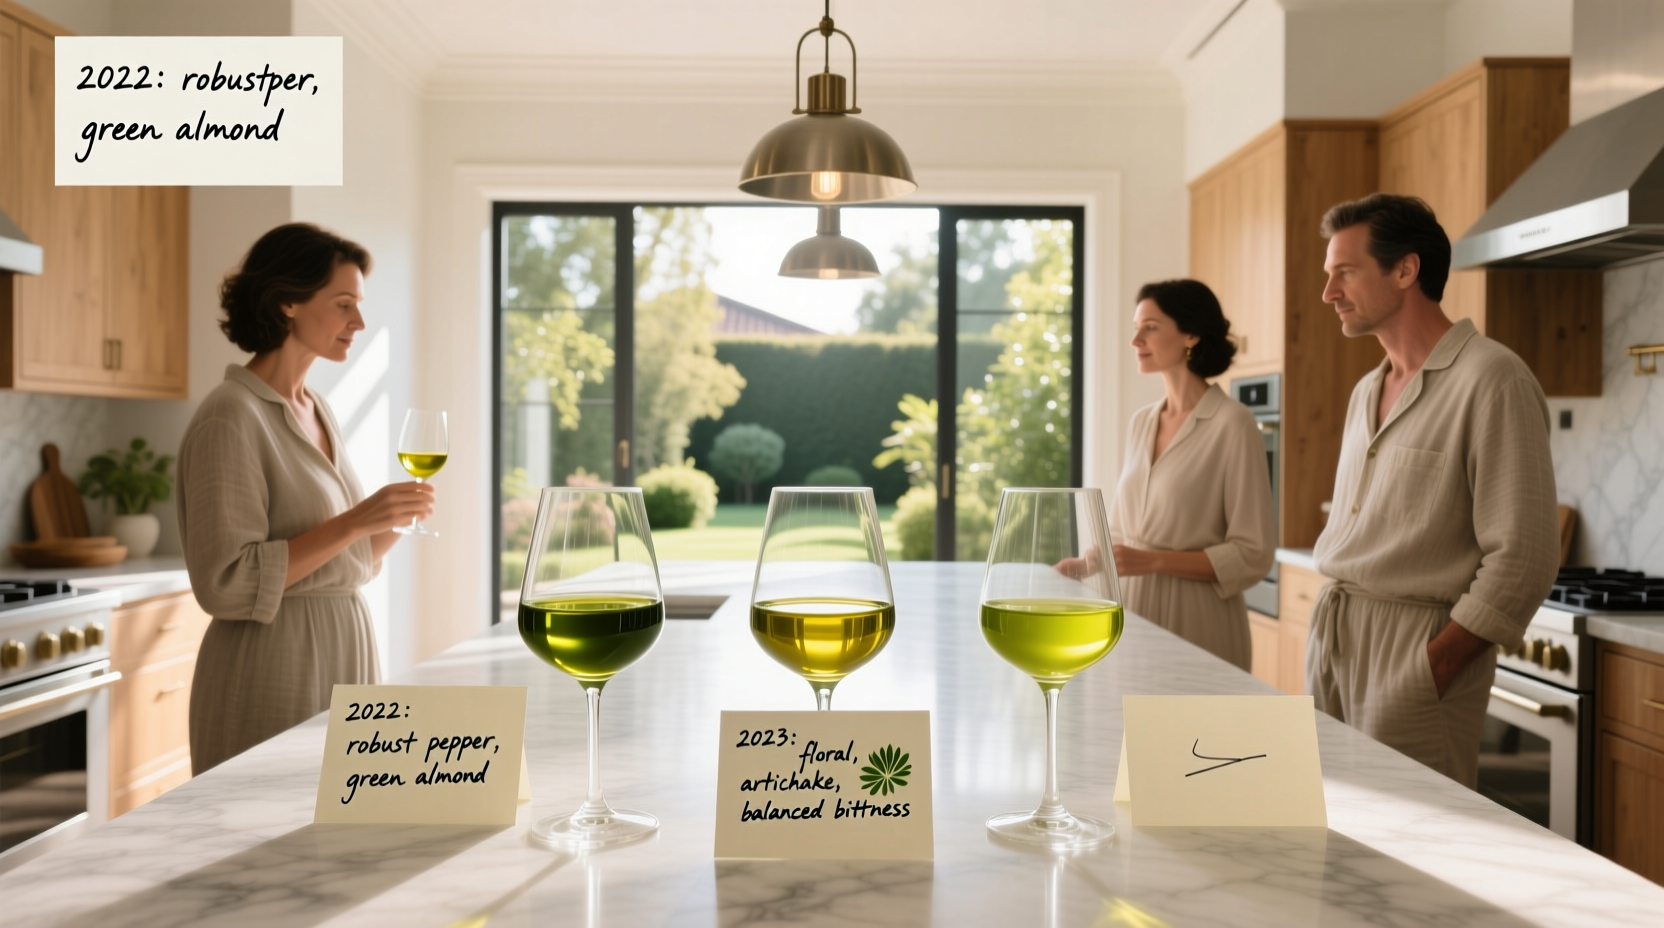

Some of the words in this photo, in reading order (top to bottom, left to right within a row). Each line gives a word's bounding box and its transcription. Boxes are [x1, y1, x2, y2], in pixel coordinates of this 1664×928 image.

[344, 701, 411, 722] 2022:
[346, 730, 419, 756] robust
[424, 735, 500, 764] pepper,
[735, 727, 797, 749] 2023:
[798, 739, 858, 775] floral,
[340, 772, 406, 805] green
[414, 759, 490, 786] almond
[740, 798, 826, 823] balanced
